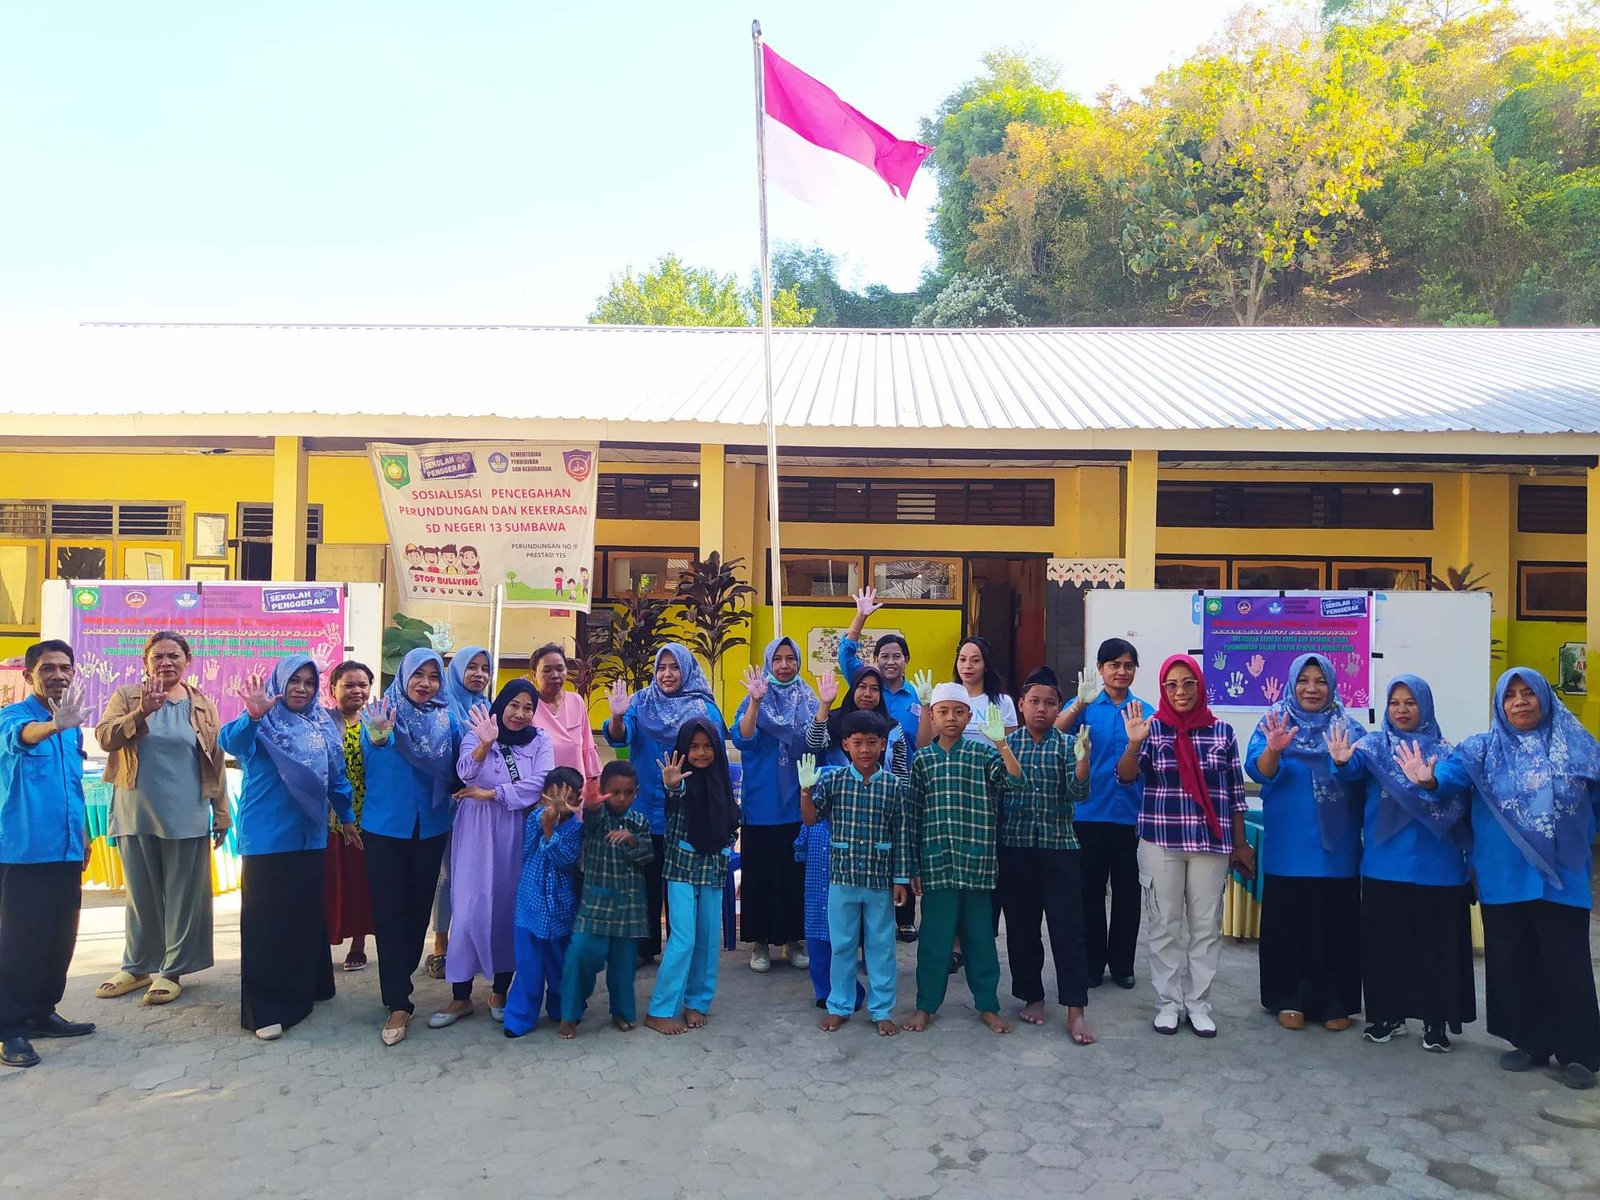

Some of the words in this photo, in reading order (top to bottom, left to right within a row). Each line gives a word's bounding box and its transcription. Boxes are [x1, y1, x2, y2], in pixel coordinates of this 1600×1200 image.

[424, 456, 455, 470] SEKOLAH
[426, 463, 467, 478] PENGGERAK
[411, 488, 482, 500] SOSIALISASI
[491, 488, 571, 499] PENCEGAHAN
[399, 505, 488, 517] PERUNDUNGAN
[492, 505, 517, 516] DAN
[520, 505, 588, 516] KEKERASAN
[425, 523, 441, 533] SD
[444, 522, 486, 533] NEGERI
[489, 522, 502, 532] 13
[505, 522, 566, 532] SUMBAWA
[414, 574, 436, 584] STOP
[437, 575, 479, 586] BULLYING
[269, 591, 311, 602] SEKOLAH
[271, 598, 326, 610] PENGGERAK
[1325, 599, 1351, 609] SEKOLAH
[1326, 605, 1359, 615] PENGGERAK
